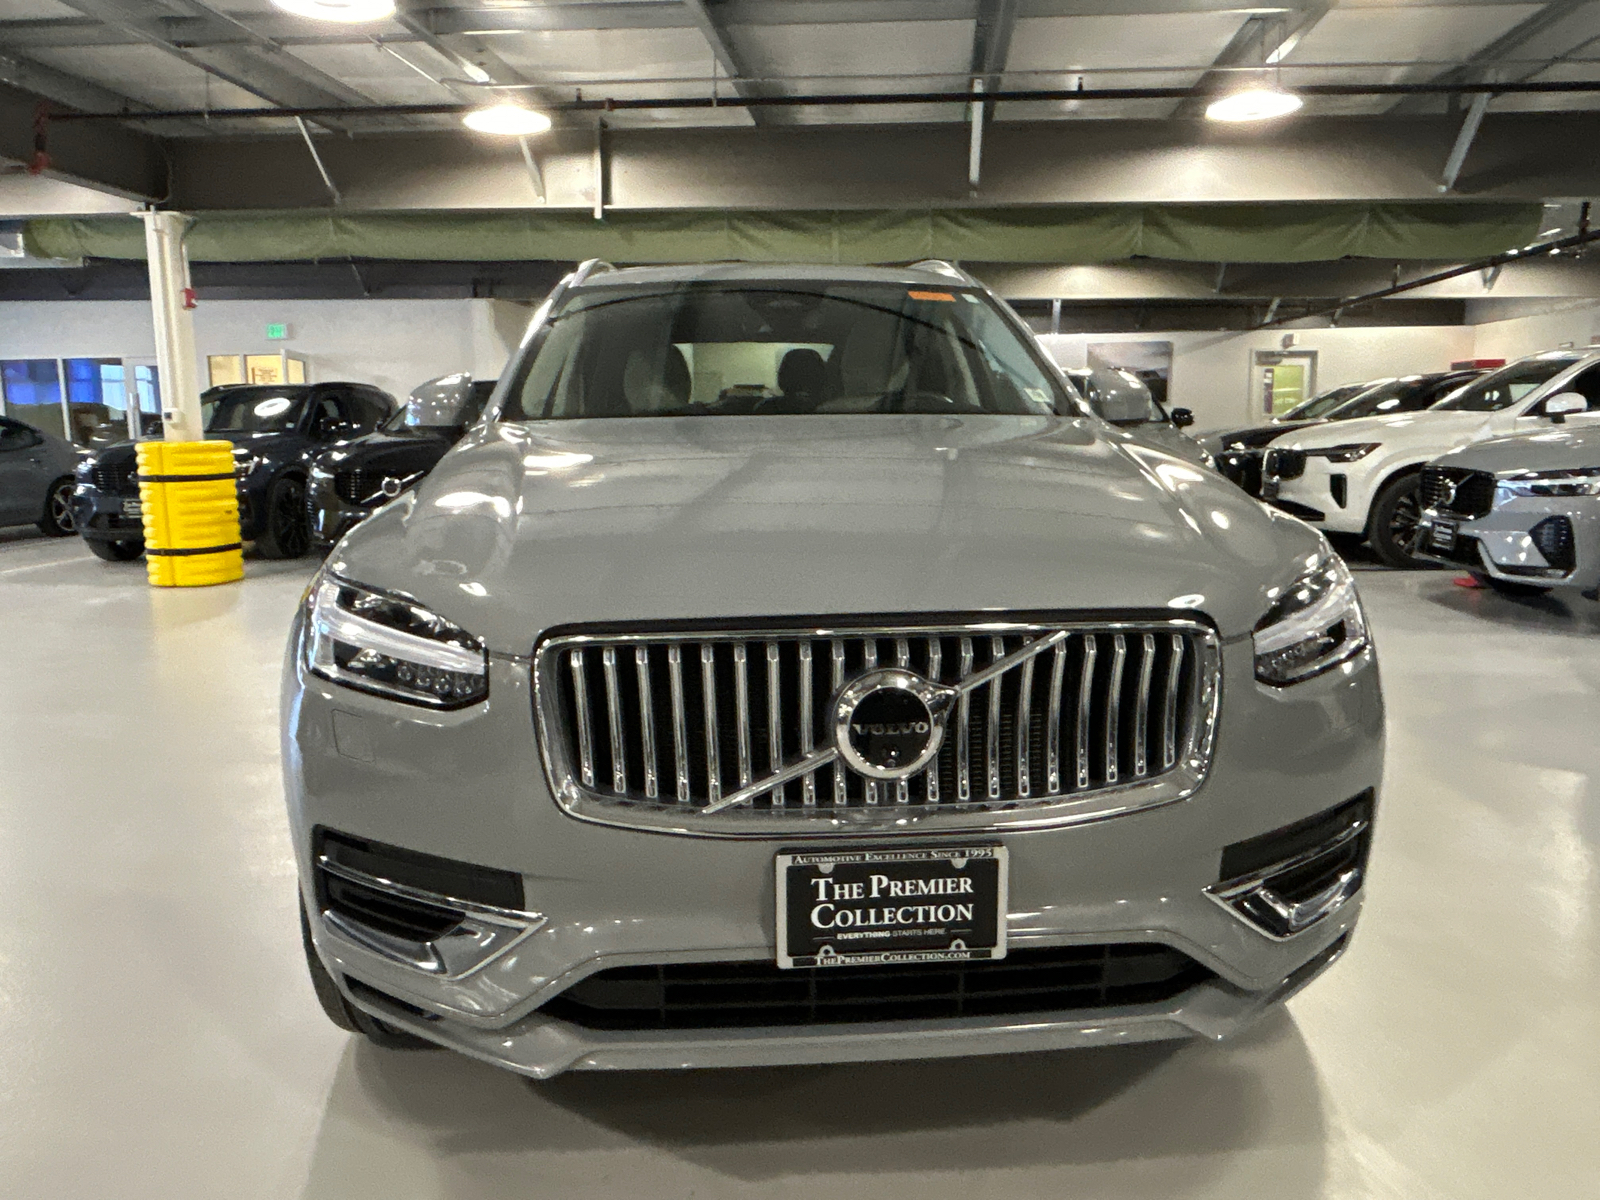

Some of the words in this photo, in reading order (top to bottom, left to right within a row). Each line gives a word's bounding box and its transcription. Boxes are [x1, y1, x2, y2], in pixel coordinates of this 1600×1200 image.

[852, 721, 929, 735] VOLVO
[795, 855, 862, 864] AUTOMOTIVE
[865, 852, 927, 862] EXCELLENCE
[931, 850, 960, 859] SINCE
[810, 877, 864, 902] THE
[869, 874, 974, 898] PREMIER
[810, 903, 974, 929] COLLECTION
[837, 930, 891, 940] EVERYTHING
